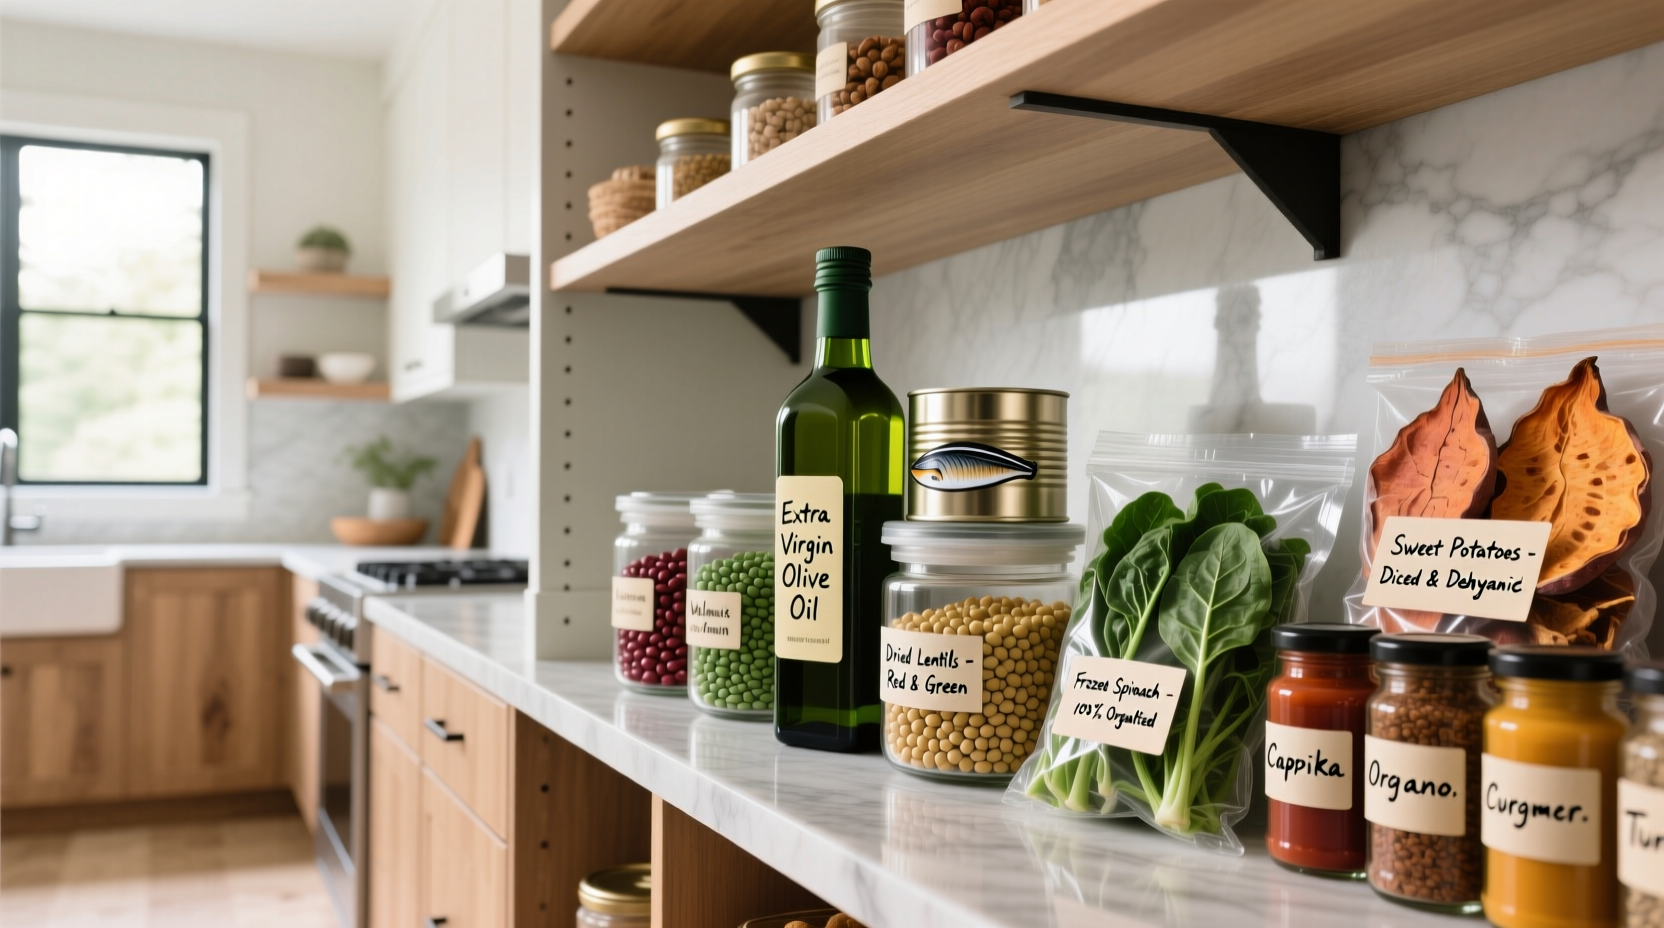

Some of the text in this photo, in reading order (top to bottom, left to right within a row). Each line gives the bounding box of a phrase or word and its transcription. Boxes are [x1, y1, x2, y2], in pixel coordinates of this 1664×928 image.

[781, 500, 831, 525] Extra
[781, 532, 833, 564] Virgin
[1390, 534, 1444, 556] Sweet
[1449, 536, 1521, 561] Potatoes
[782, 562, 830, 589] Olive
[1379, 565, 1423, 587] Diced
[1426, 569, 1439, 588] &
[790, 594, 818, 621] Oil
[886, 643, 913, 665] Dried
[917, 647, 959, 669] Lentils
[887, 669, 968, 694] Red & Green
[1267, 742, 1345, 782] Cappika
[1368, 759, 1457, 802] Organo.
